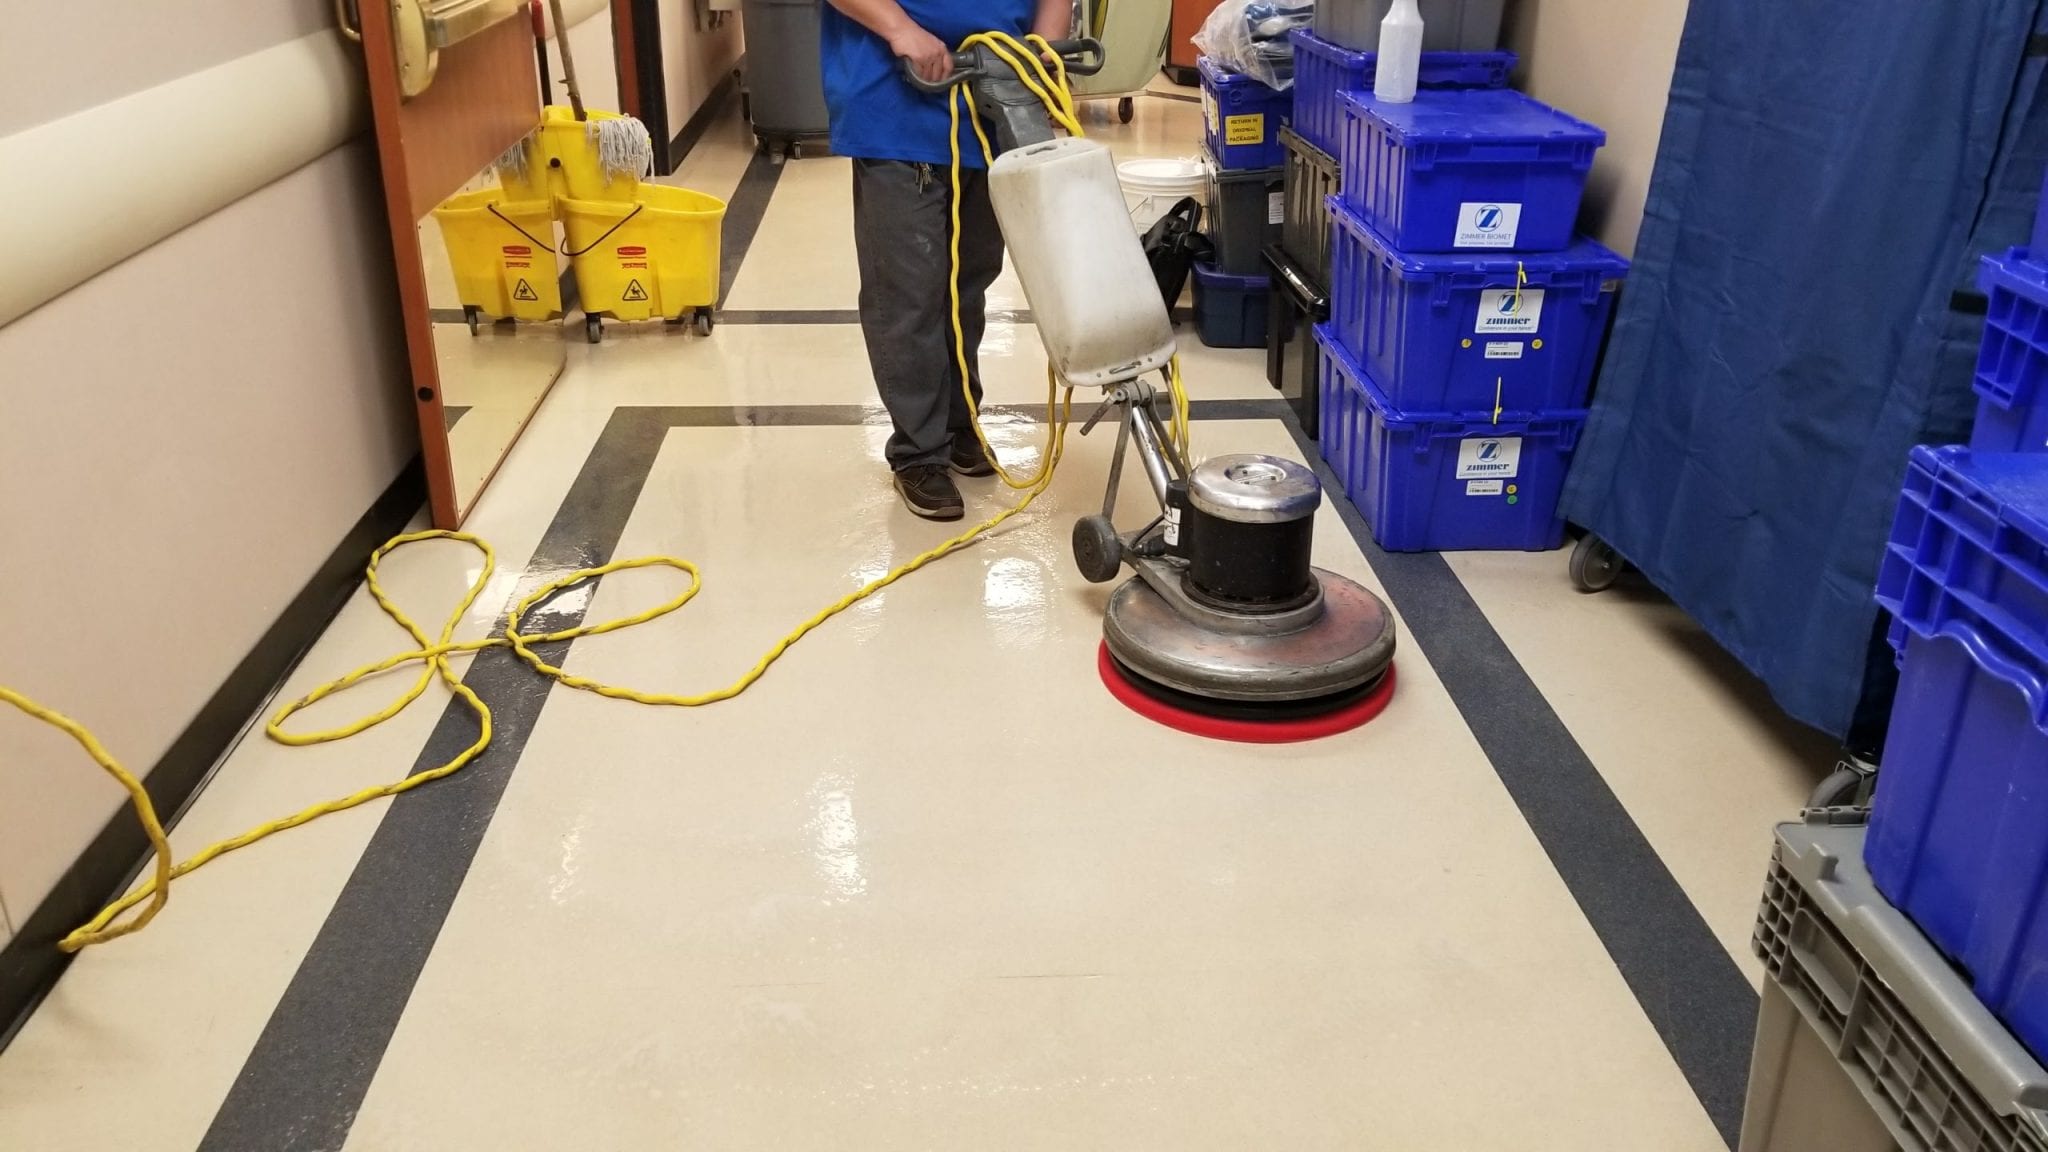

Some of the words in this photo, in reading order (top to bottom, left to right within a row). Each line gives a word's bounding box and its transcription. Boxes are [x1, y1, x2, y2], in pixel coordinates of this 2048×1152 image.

[1478, 208, 1500, 228] Z
[1500, 294, 1521, 312] Z
[1486, 317, 1531, 325] zimmer
[1479, 442, 1500, 459] Z
[1466, 463, 1510, 471] zimmer
